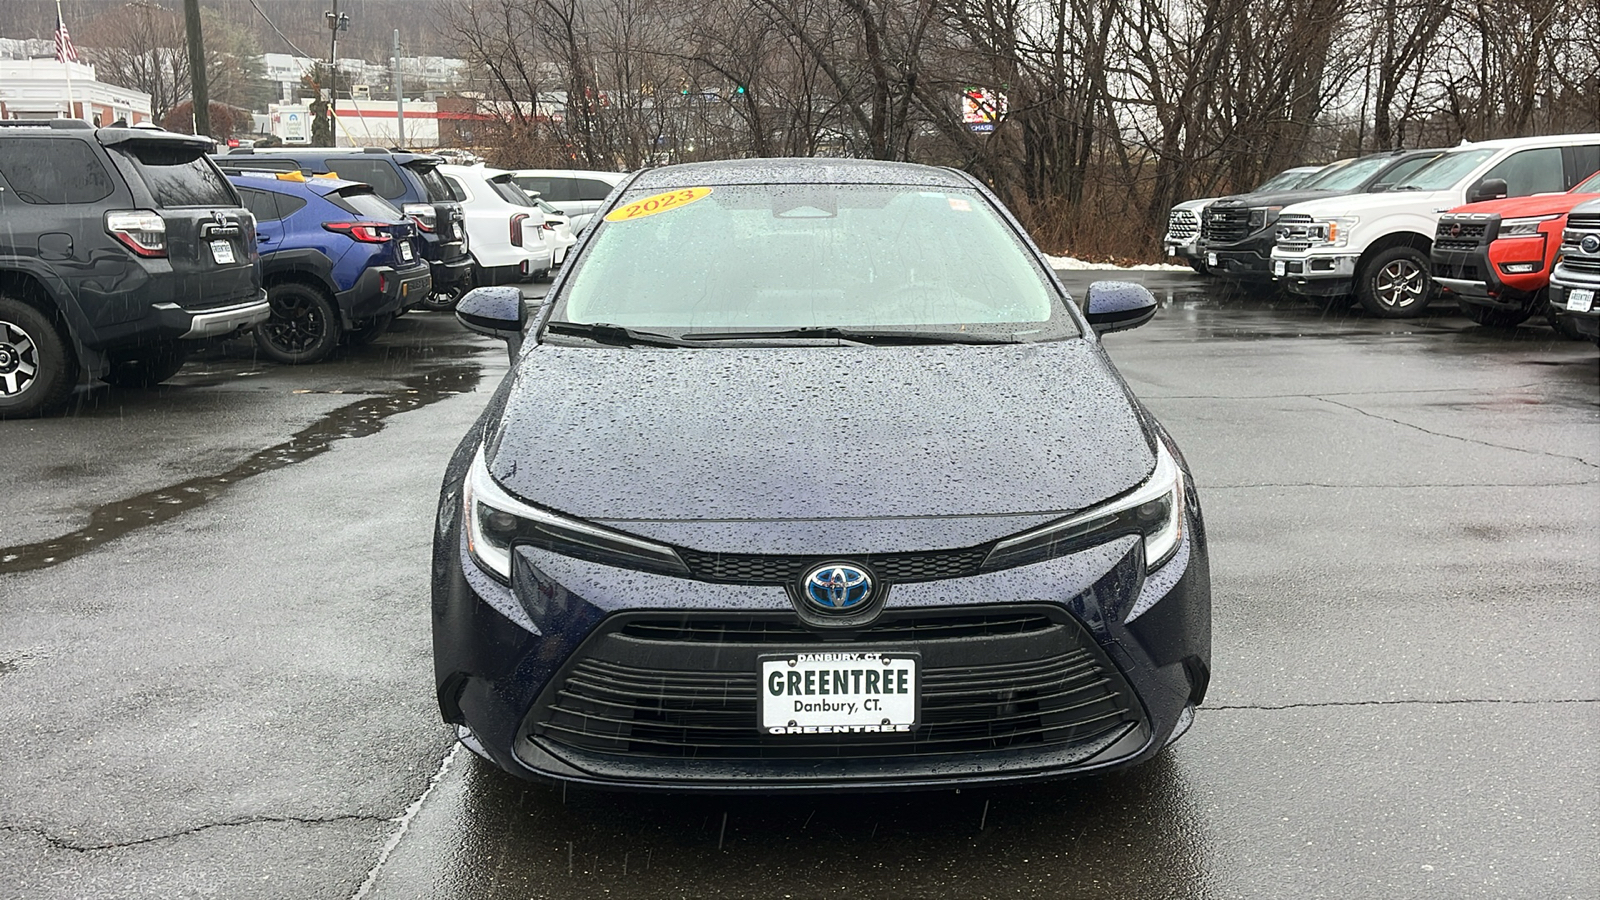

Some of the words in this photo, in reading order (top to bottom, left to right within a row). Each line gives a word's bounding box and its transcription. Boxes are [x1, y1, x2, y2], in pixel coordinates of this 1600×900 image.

[626, 190, 694, 218] 2023
[768, 669, 908, 696] GREENTREE
[794, 699, 858, 715] Danbury,
[863, 699, 882, 711] CT.
[769, 725, 910, 734] GREENTREE
